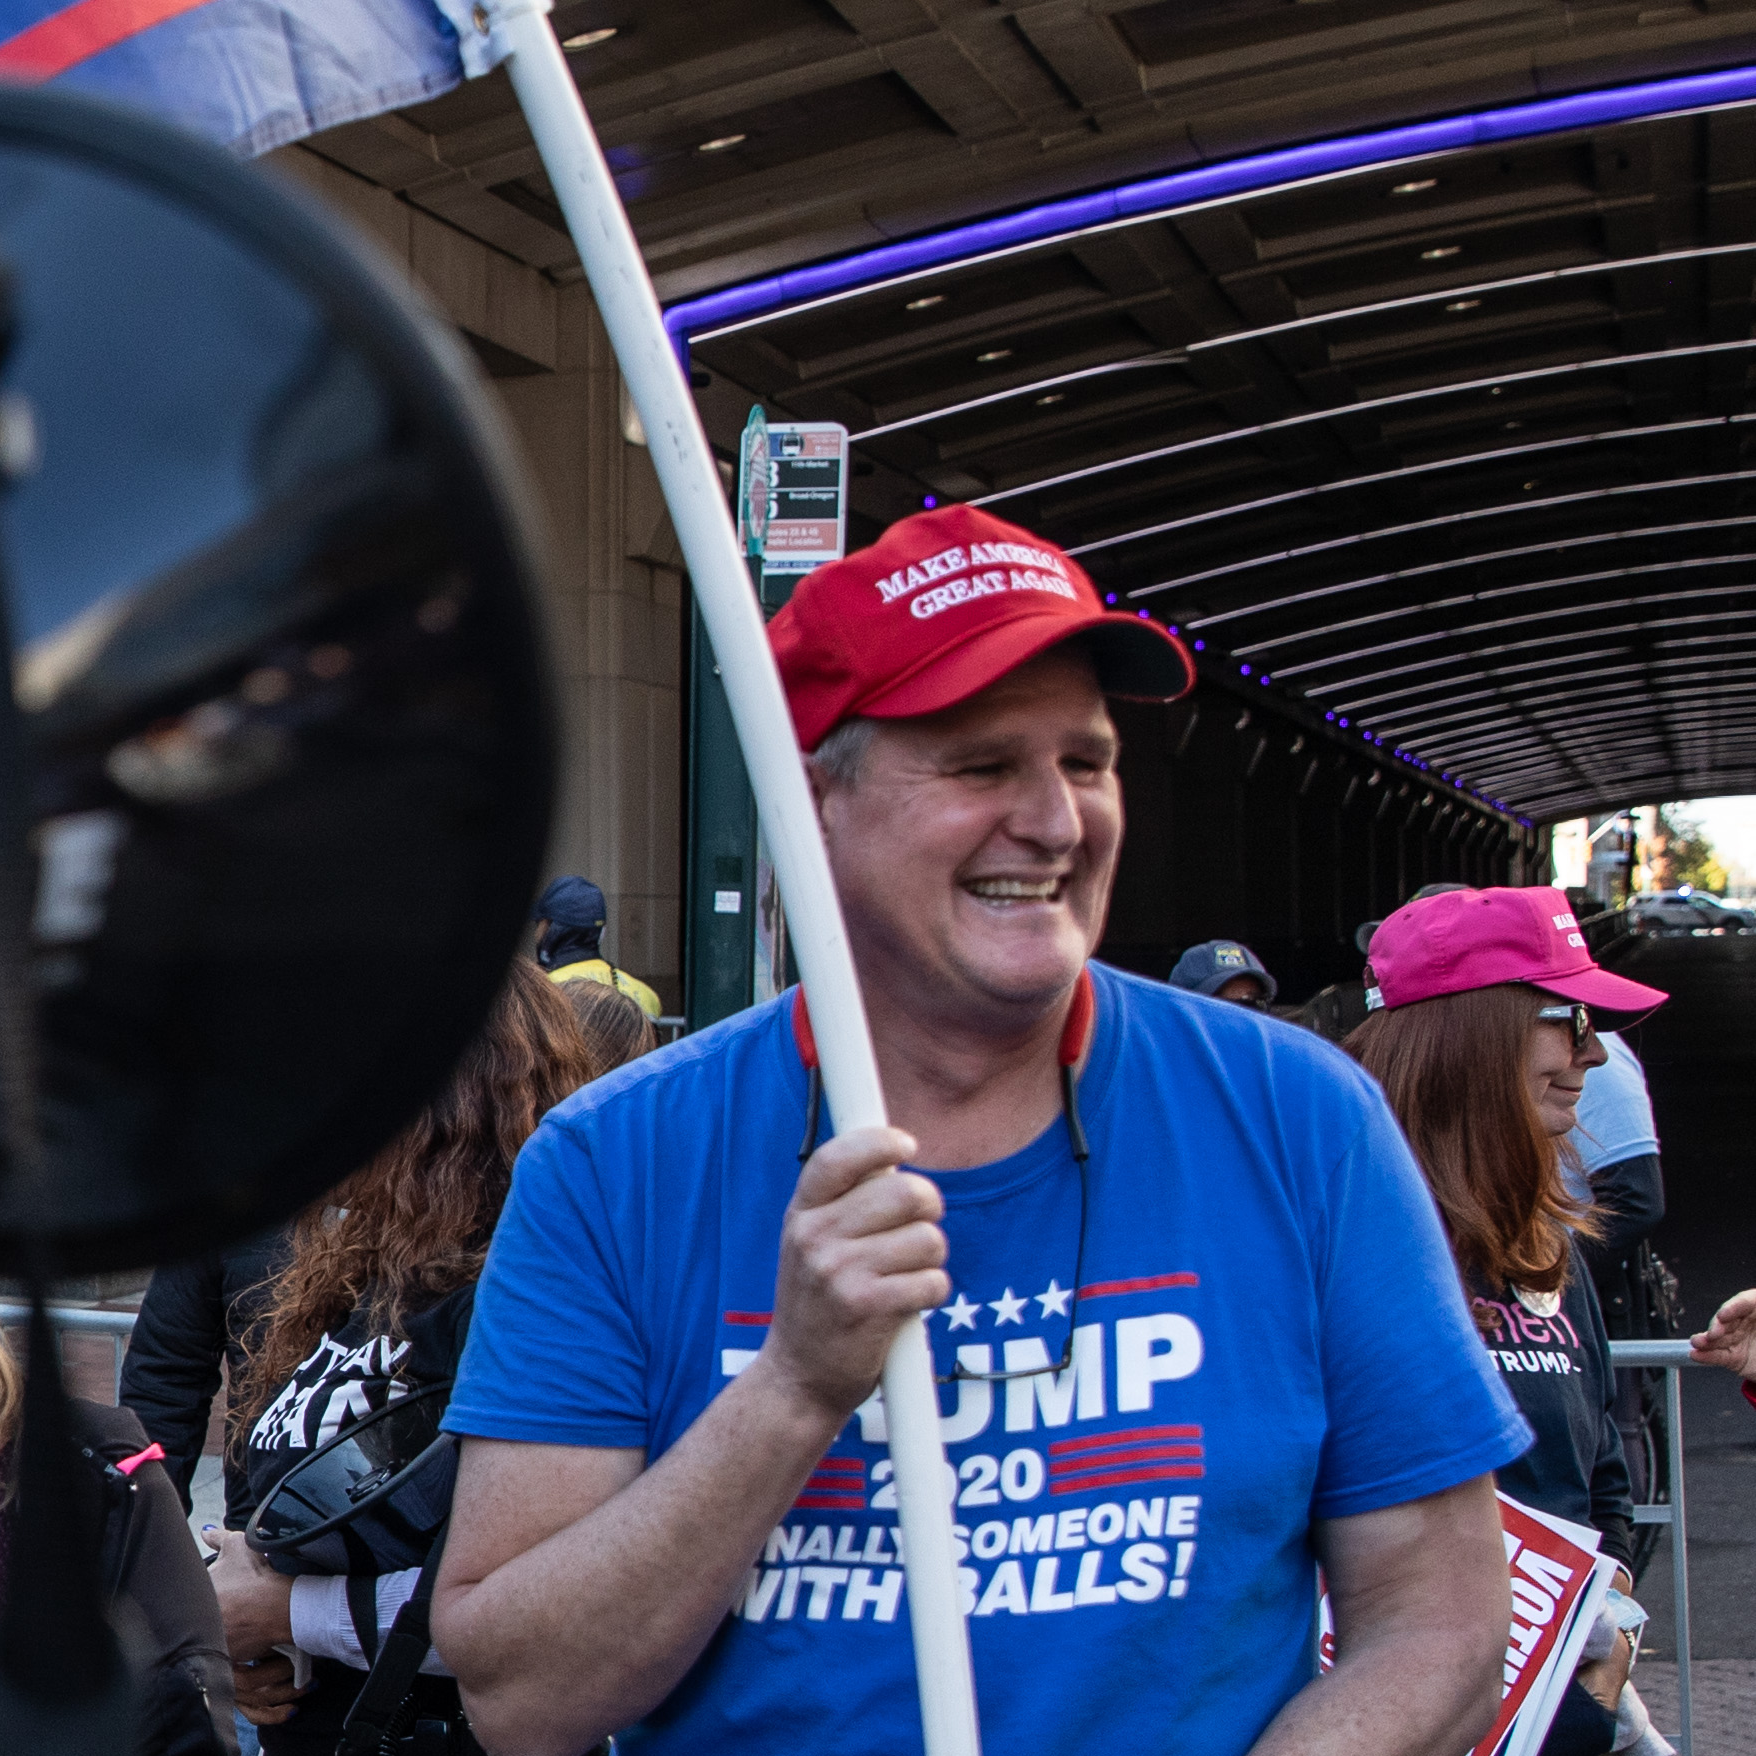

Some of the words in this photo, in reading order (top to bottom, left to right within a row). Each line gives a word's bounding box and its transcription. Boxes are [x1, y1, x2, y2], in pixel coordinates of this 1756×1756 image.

[875, 547, 969, 603] MAKE
[970, 541, 1069, 579] AMERICA
[910, 570, 1007, 619] GREAT
[1010, 570, 1079, 602] AGAIN
[871, 1448, 1045, 1509] 220
[730, 1565, 903, 1623] WITH
